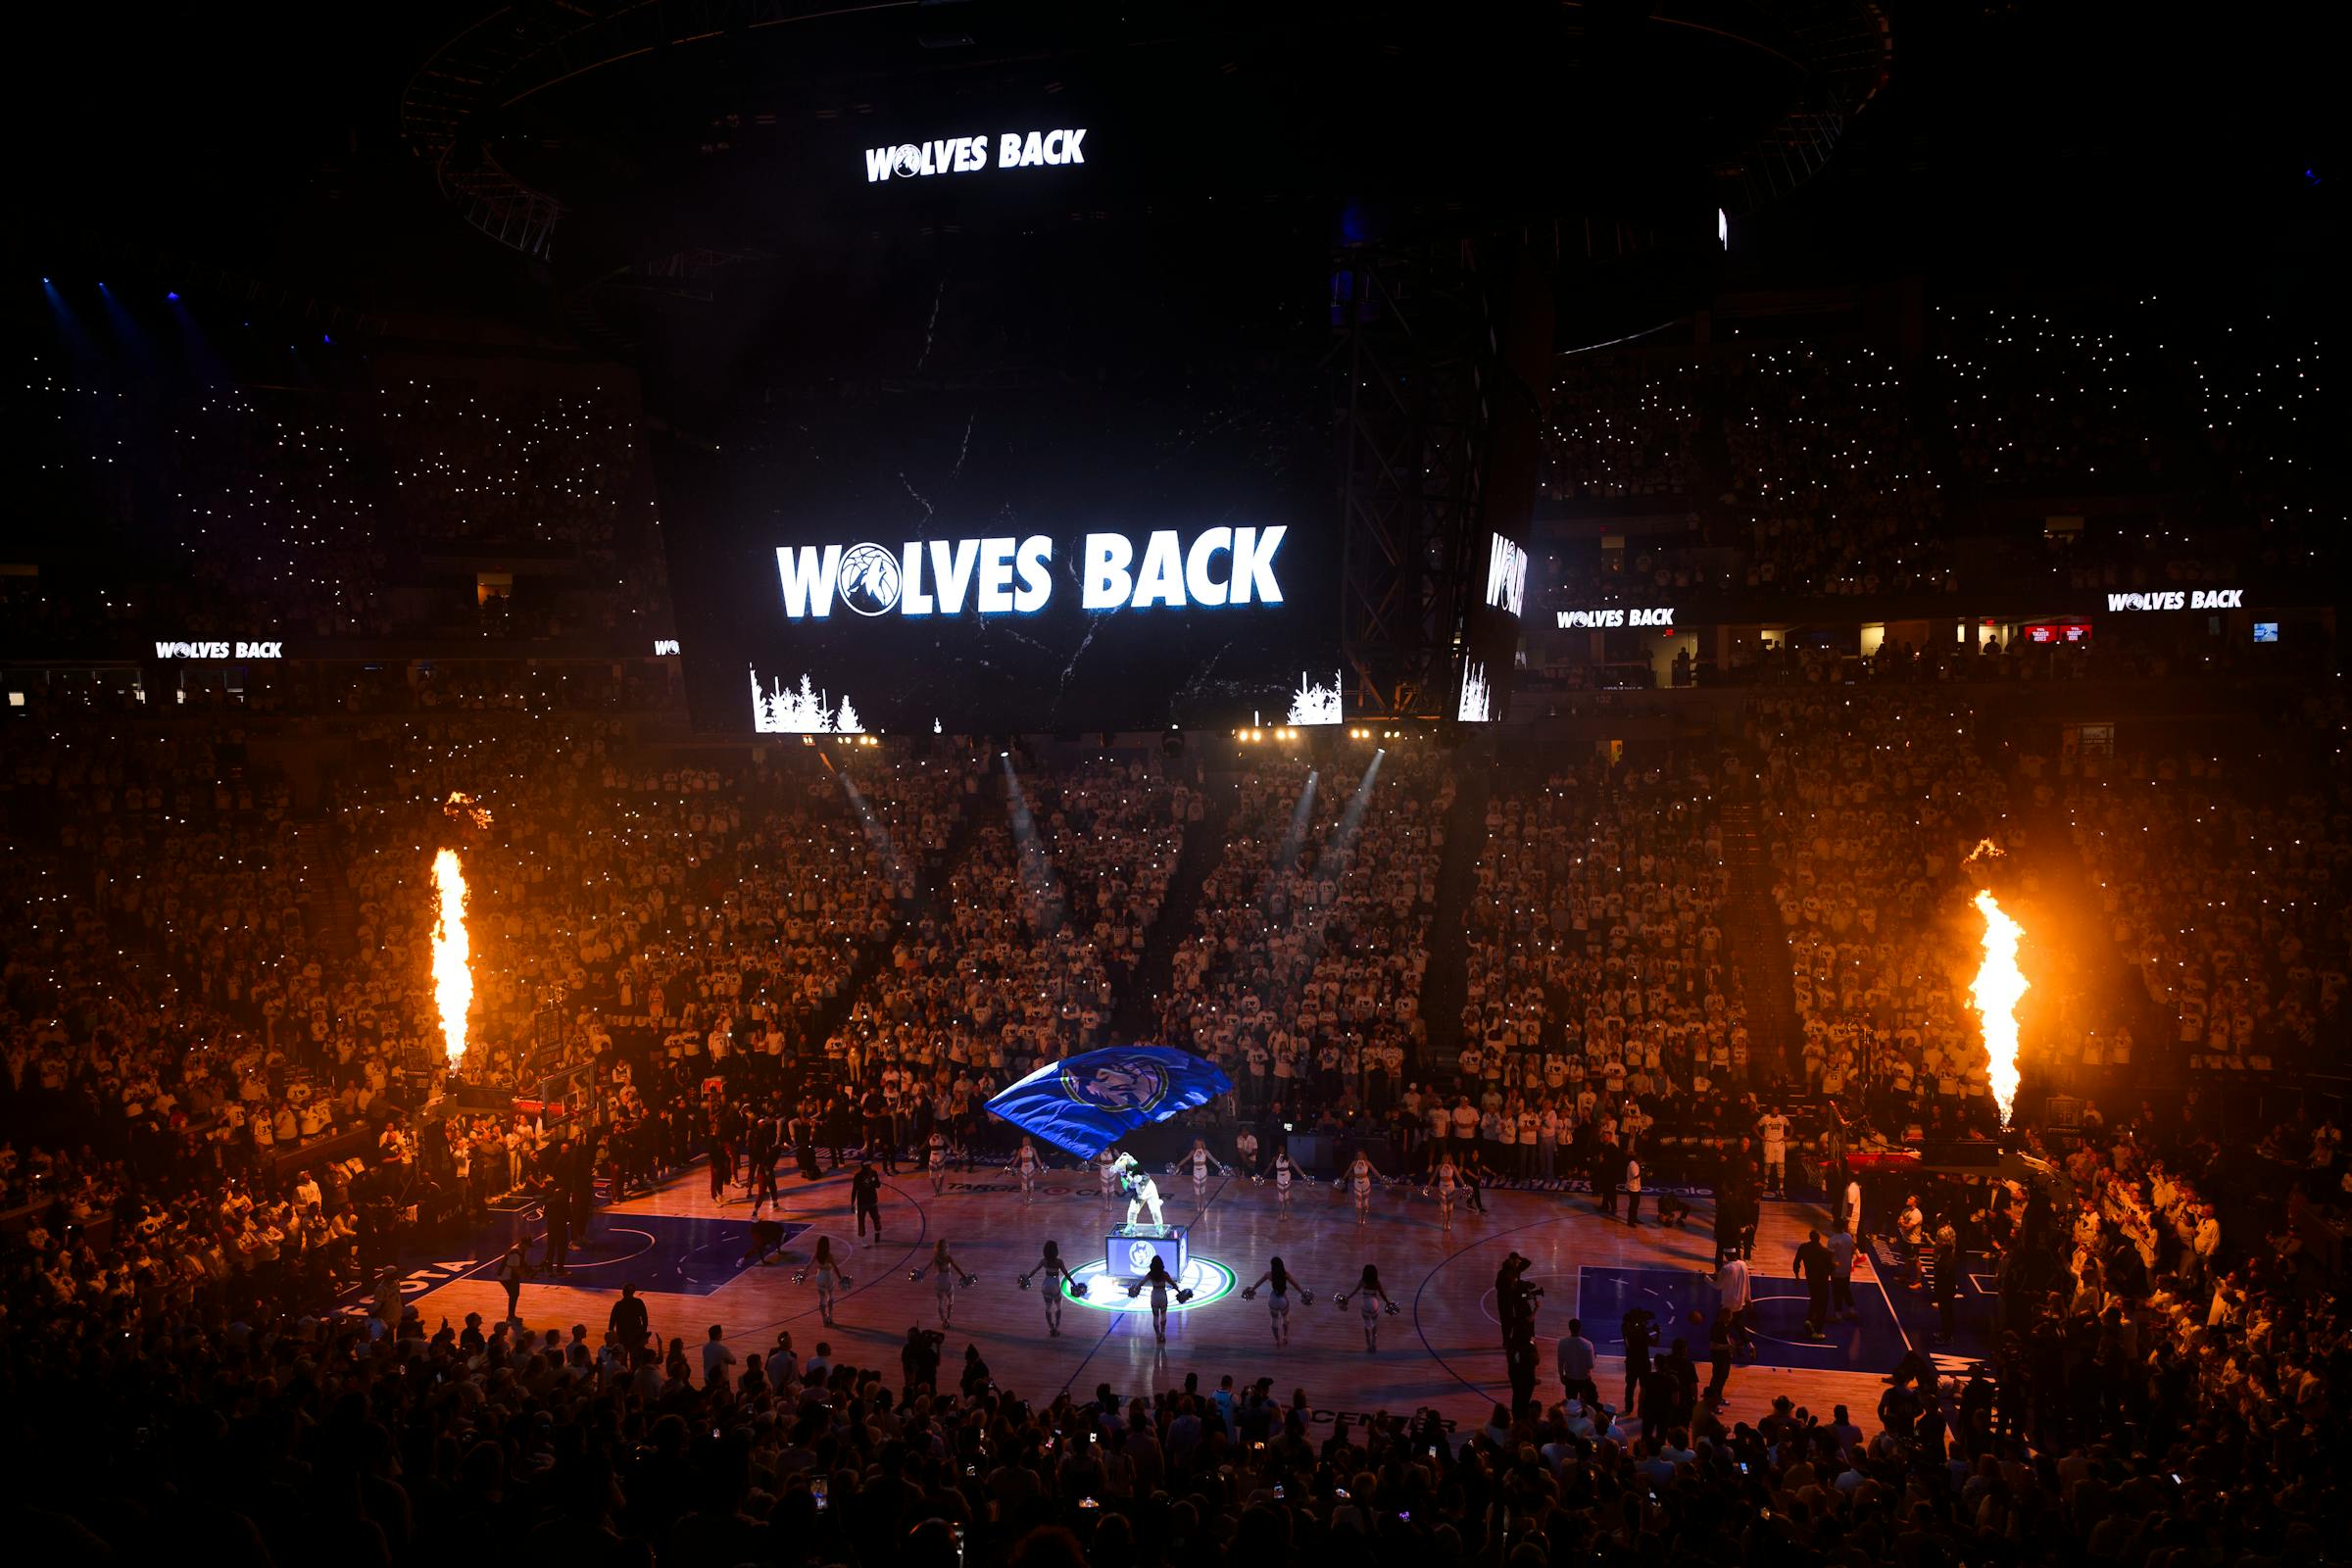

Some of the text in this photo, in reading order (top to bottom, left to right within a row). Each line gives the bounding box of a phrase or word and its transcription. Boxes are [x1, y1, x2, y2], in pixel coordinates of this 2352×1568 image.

[865, 129, 1087, 182] WOLVES BACK
[775, 525, 1287, 617] WOLVES BACK
[2108, 590, 2243, 612] WOLVES BACK
[1557, 609, 1674, 628] WOLVES BACK
[156, 642, 282, 659] WOLVES BACK
[655, 640, 680, 656] WO
[948, 1182, 1043, 1193] TARGE
